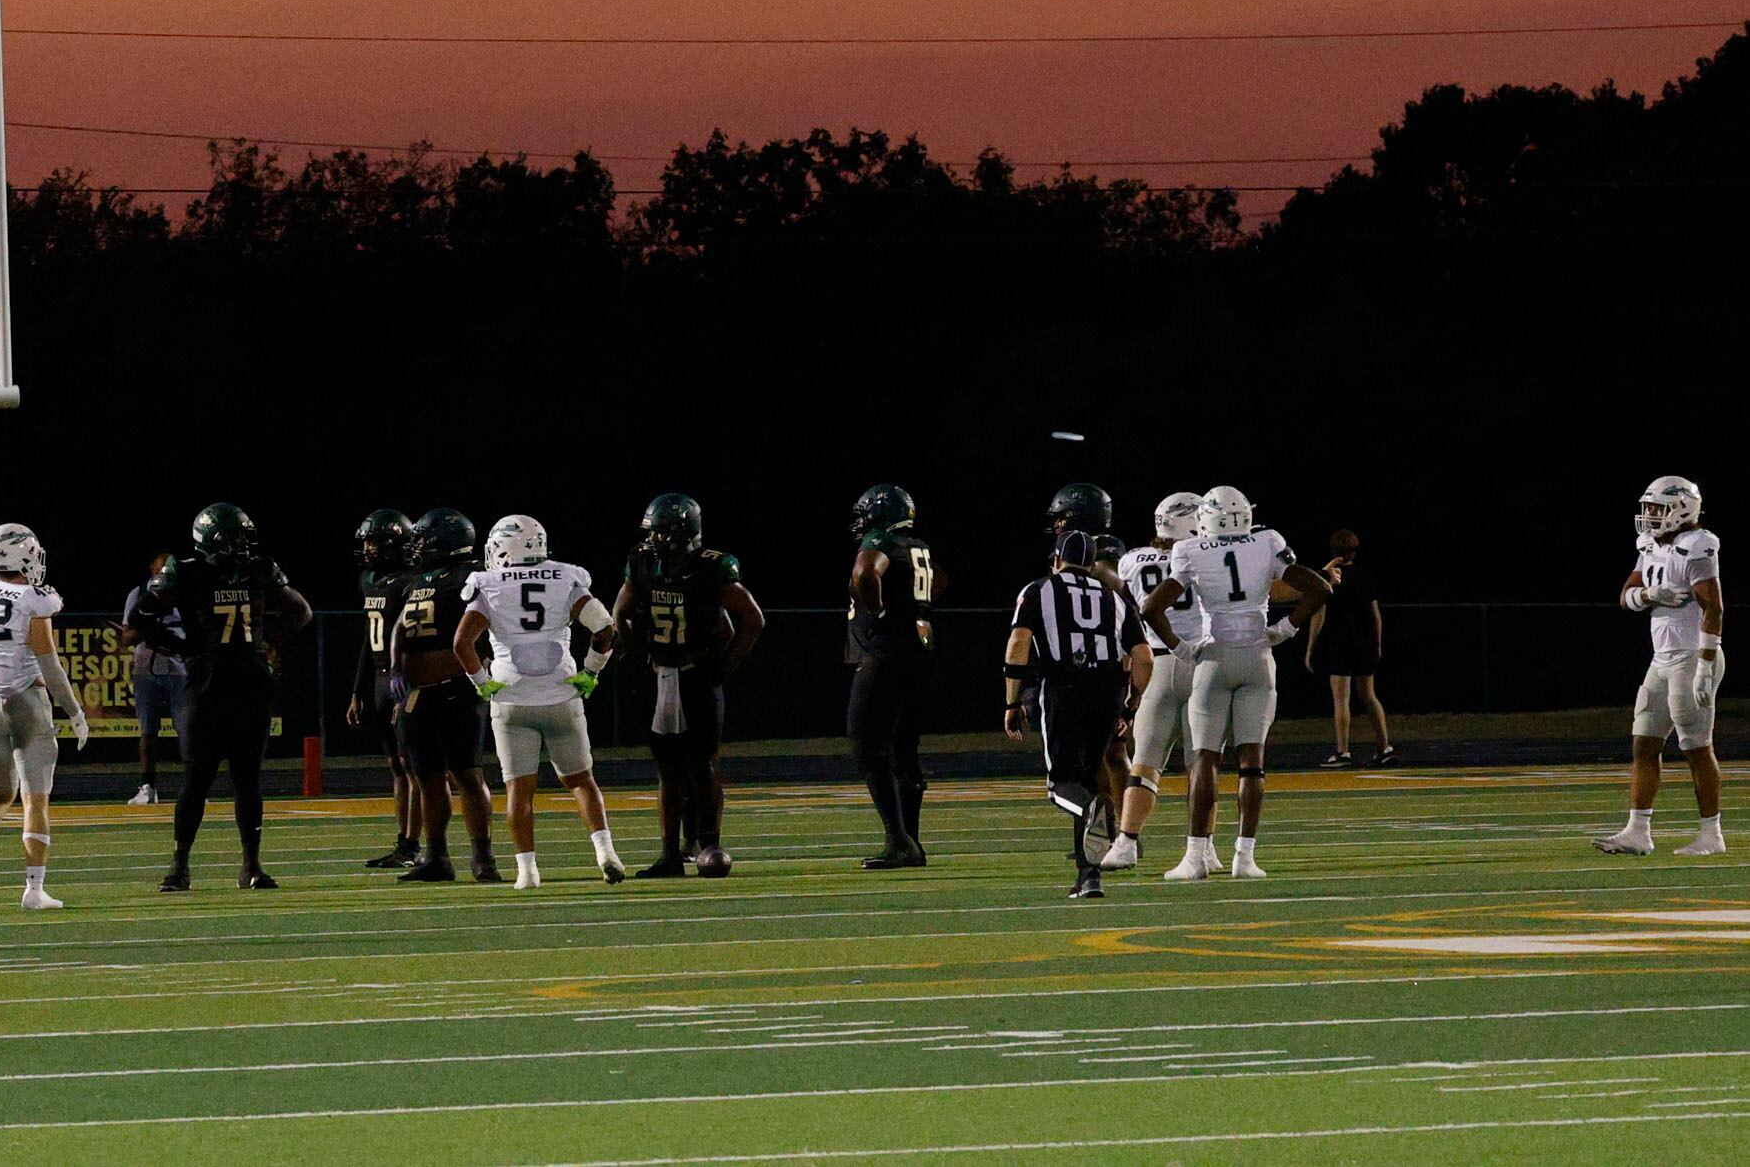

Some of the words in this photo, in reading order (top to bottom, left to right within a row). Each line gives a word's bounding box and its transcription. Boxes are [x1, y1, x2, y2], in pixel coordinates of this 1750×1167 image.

[501, 569, 562, 582] PIERCE
[1224, 551, 1246, 602] 1
[1647, 565, 1664, 586] 11
[213, 589, 251, 603] DESOTO
[520, 582, 546, 631] 5
[651, 589, 685, 605] DESOTO
[1066, 585, 1103, 630] U
[212, 603, 254, 644] 71
[367, 610, 385, 653] 0
[402, 599, 438, 639] 52
[650, 604, 688, 645] 51
[52, 627, 118, 653] LET'S
[53, 682, 137, 707] AGLES
